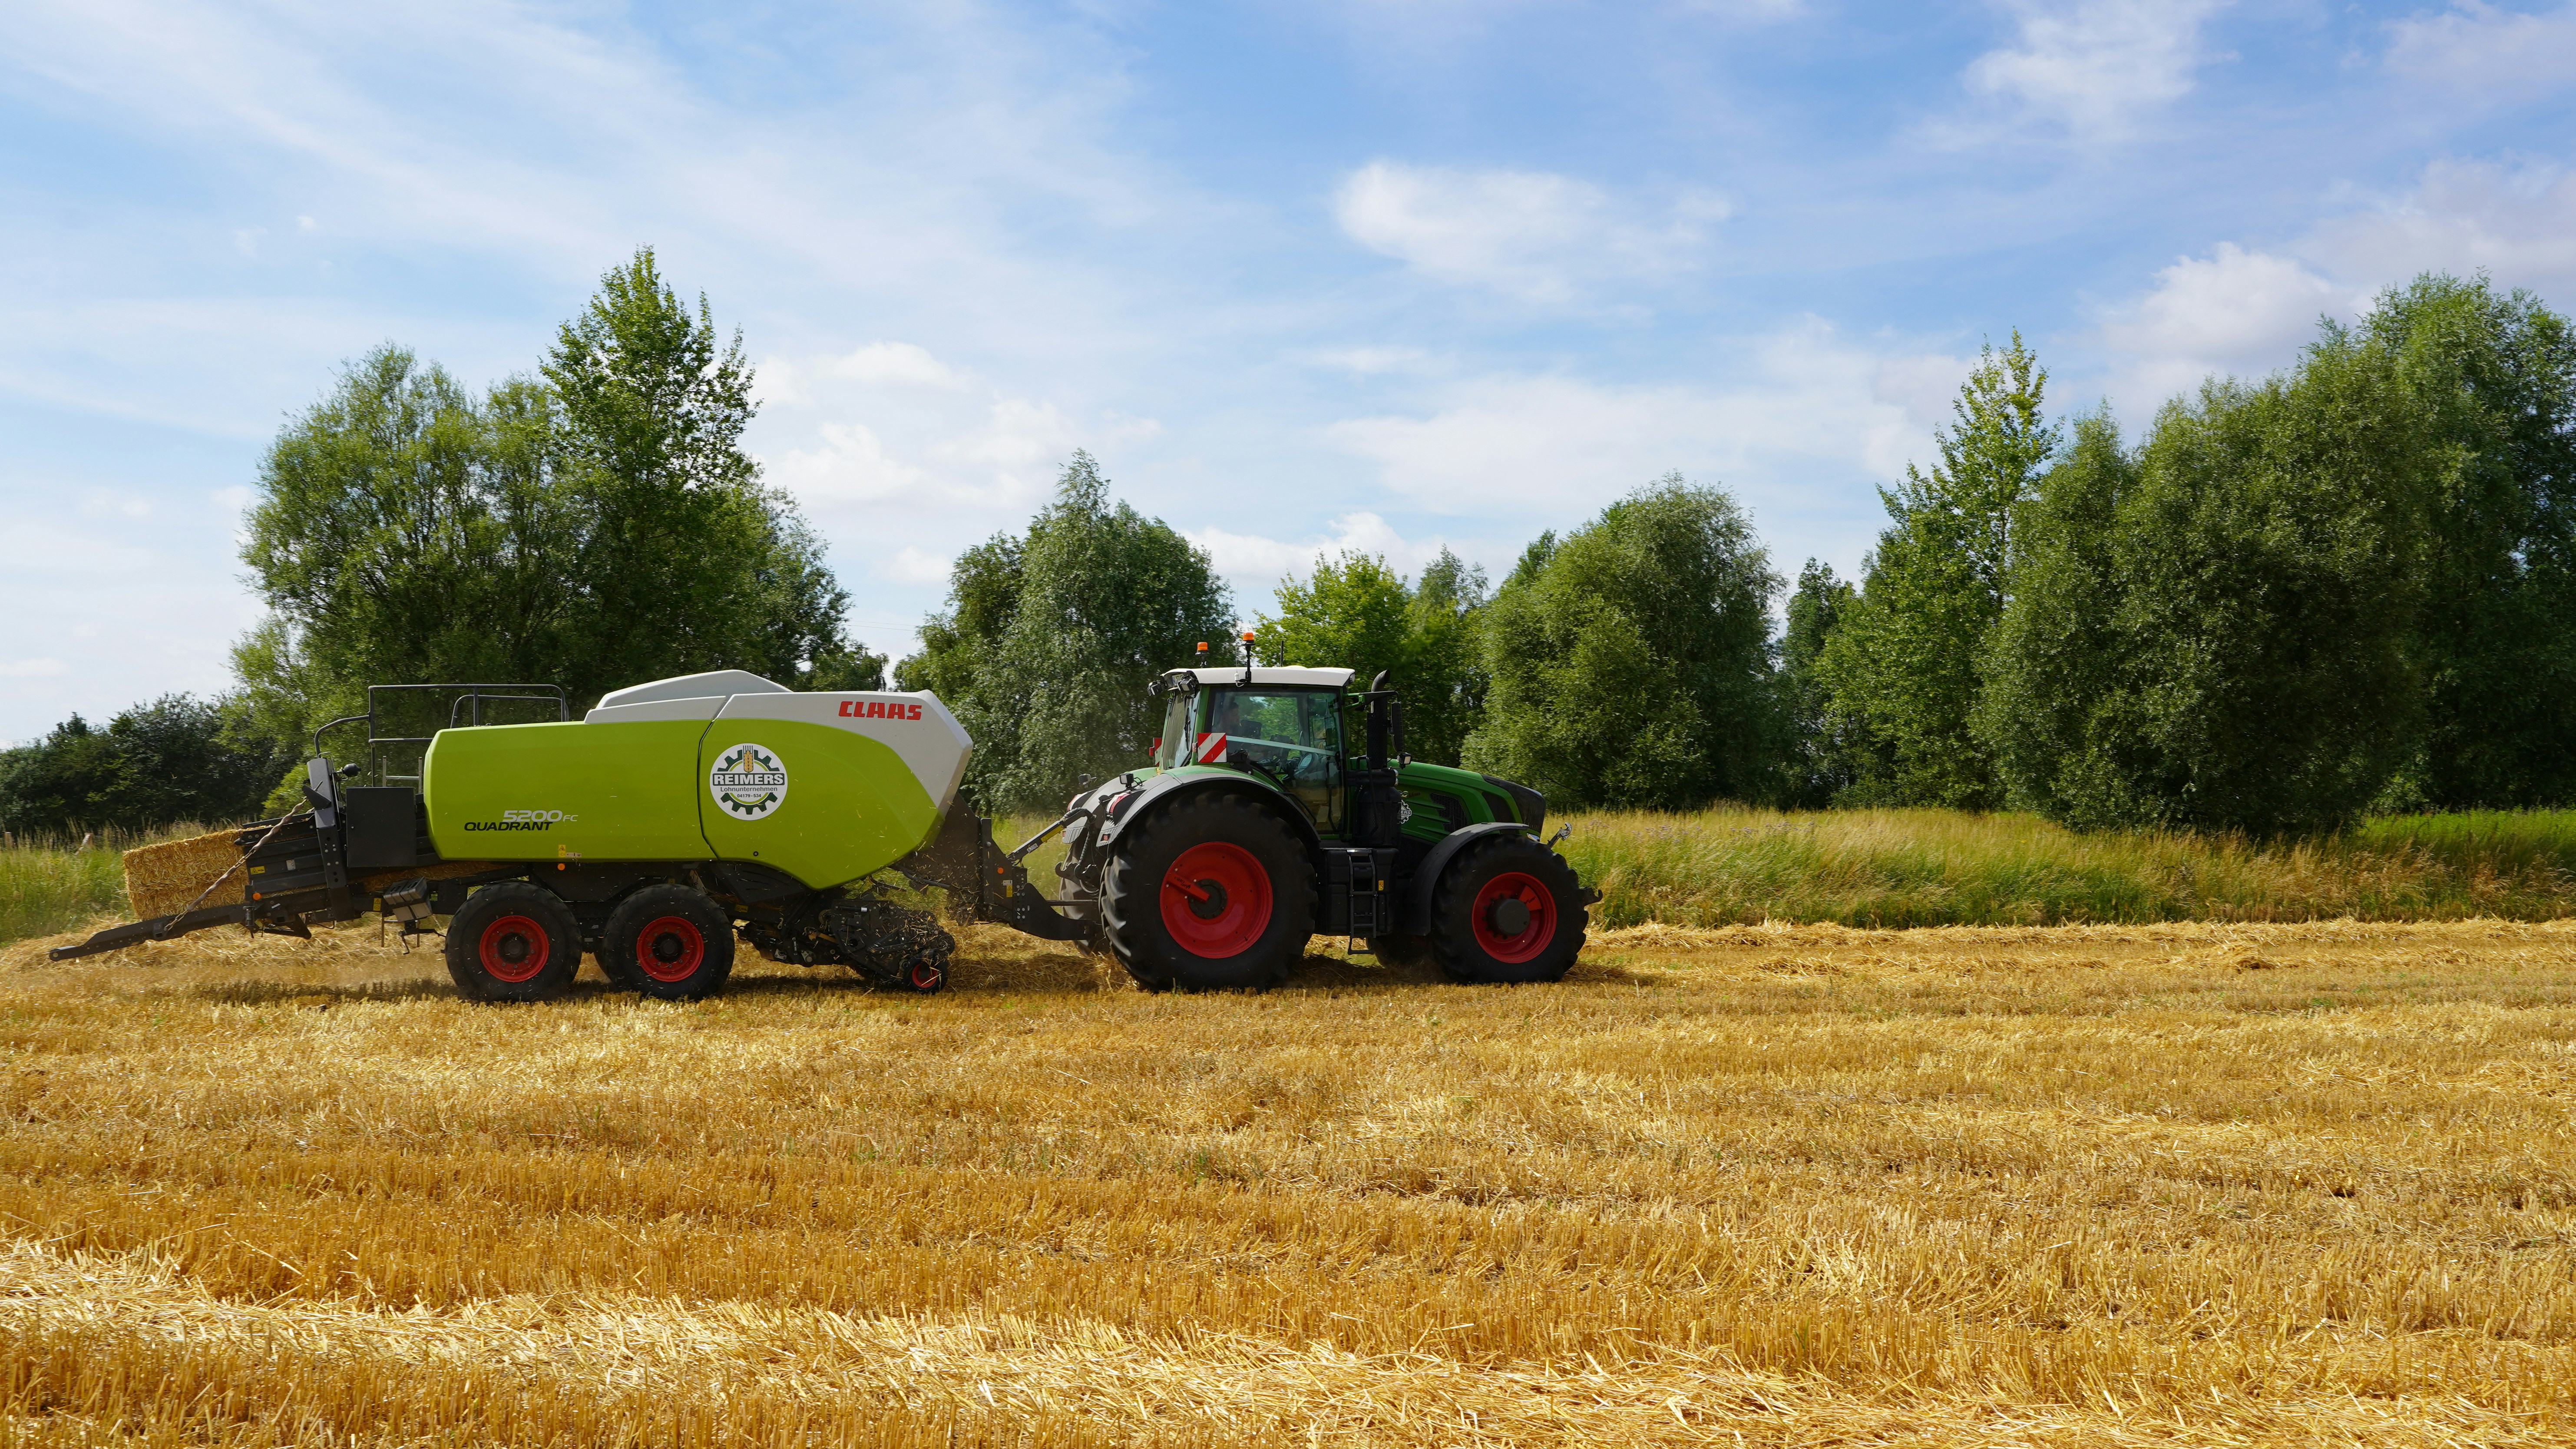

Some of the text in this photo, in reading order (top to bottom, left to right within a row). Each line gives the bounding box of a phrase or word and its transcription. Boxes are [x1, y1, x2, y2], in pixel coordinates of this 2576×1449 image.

[838, 701, 922, 720] CLAAS
[714, 774, 784, 785] REIMERS
[503, 810, 563, 822] 5200
[464, 822, 553, 831] QUADRANT
